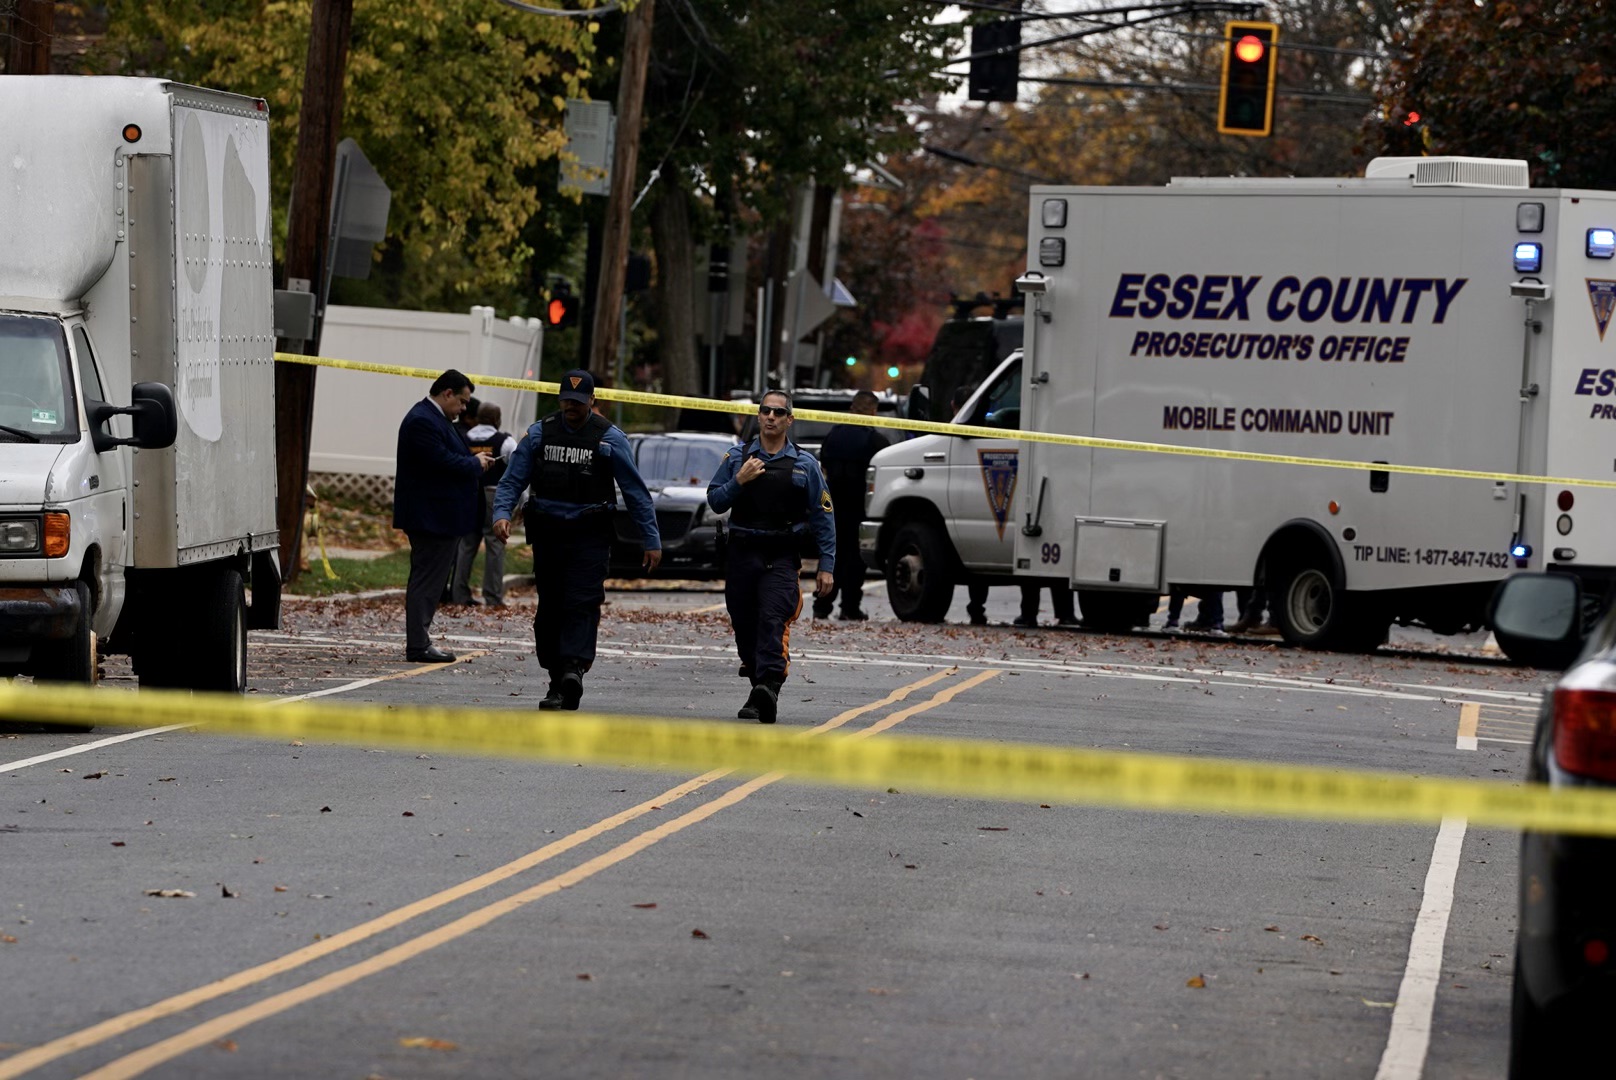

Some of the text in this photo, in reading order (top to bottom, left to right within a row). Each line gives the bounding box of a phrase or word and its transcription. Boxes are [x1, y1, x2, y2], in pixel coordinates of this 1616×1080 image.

[1109, 273, 1469, 325] ESSEX COUNTY
[1130, 331, 1411, 363] PROSECUTOR'S OFFICE
[1575, 368, 1616, 397] ES
[1163, 406, 1394, 436] MOBILE COMMAND UNIT
[544, 444, 593, 465] STATE POLICE
[1041, 543, 1061, 565] 99
[1354, 545, 1509, 569] TIP LINE: 1-877-847-7432
